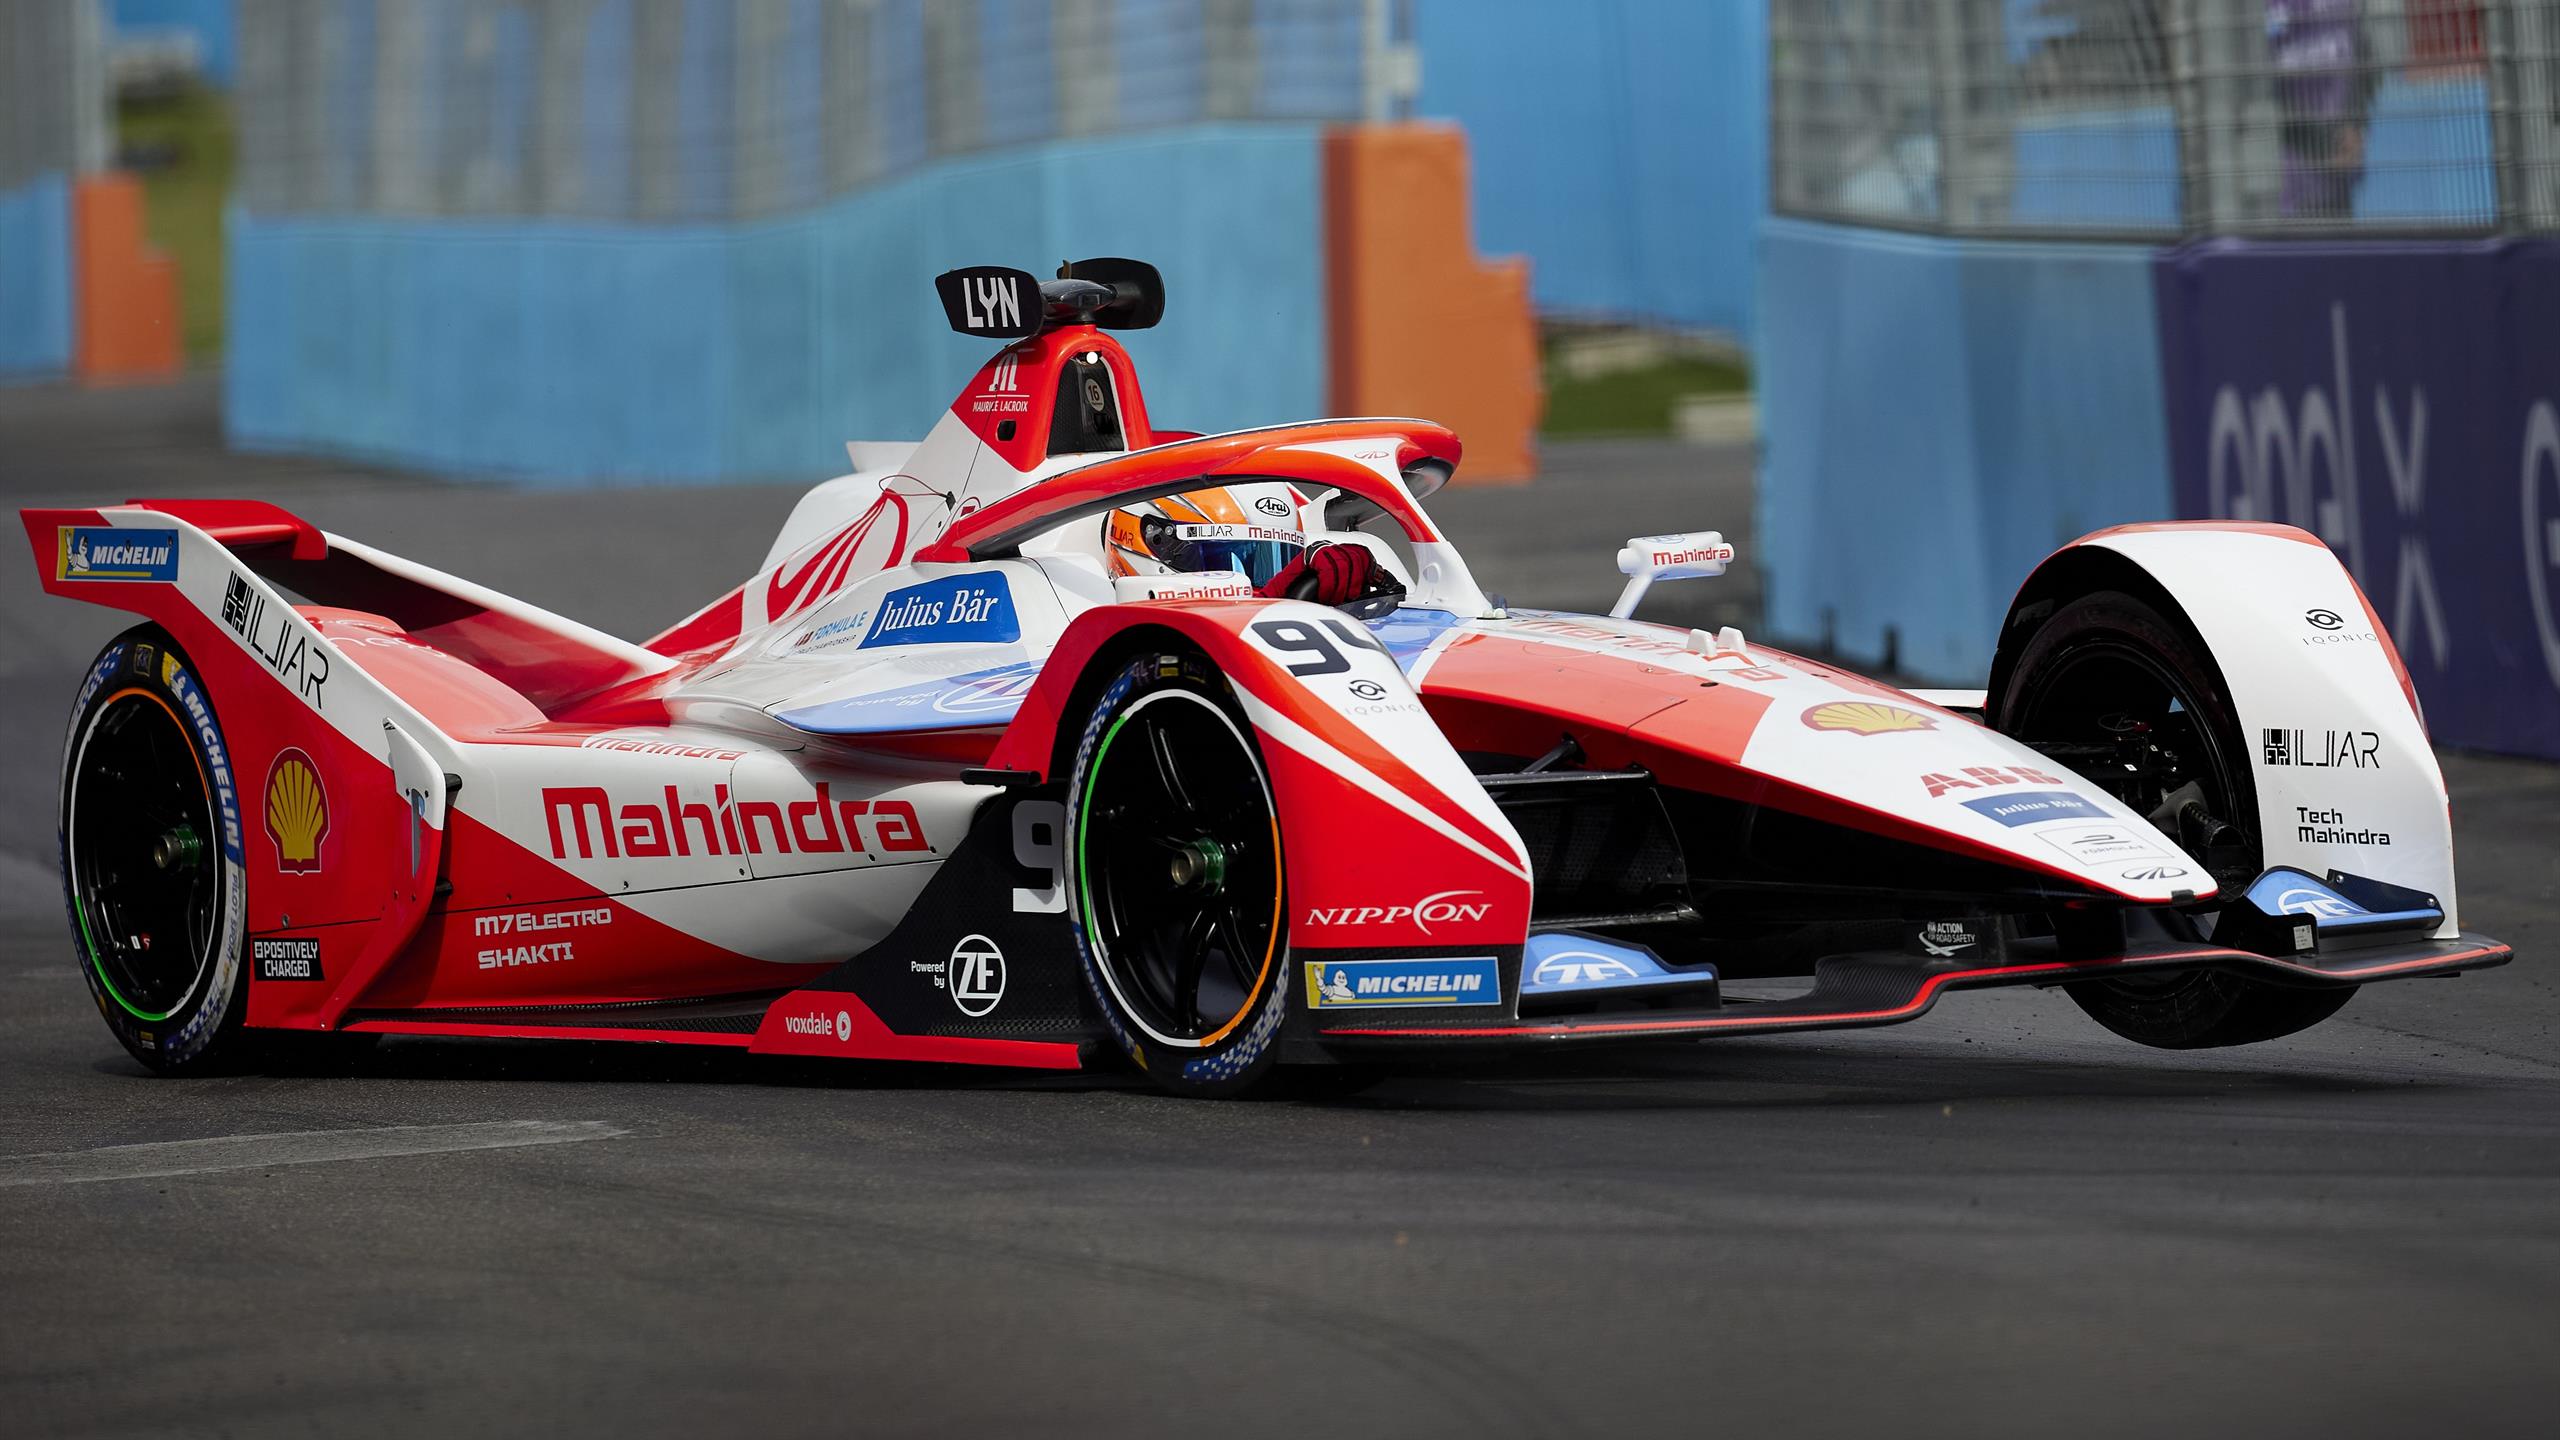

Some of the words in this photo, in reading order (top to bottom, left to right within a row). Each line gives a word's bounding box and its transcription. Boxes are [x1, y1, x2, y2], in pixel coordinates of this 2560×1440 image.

[963, 277, 1020, 328] LYN
[1088, 385, 1100, 401] 16
[1000, 400, 1029, 412] LACROIX
[1259, 498, 1287, 513] Arai
[1248, 527, 1305, 544] Mahindra
[92, 545, 170, 566] MICHELIN
[1653, 547, 1731, 566] Mahindra
[872, 593, 943, 640] Julius
[947, 588, 999, 625] Bär
[2302, 632, 2377, 646] IQONIQ
[585, 737, 748, 761] Mahindra
[185, 692, 240, 849] MICHELIN
[1920, 766, 2064, 799] ABB
[1993, 800, 2049, 817] Julius
[2296, 807, 2344, 825] Tech
[541, 781, 930, 859] Mahindra
[2298, 826, 2391, 845] Mahindra
[1306, 893, 1493, 934] NIPPON
[1937, 922, 1964, 934] ACTION
[1936, 933, 1953, 943] ROAD
[1953, 933, 1977, 943] SAFETY
[263, 941, 319, 959] POSITIVELY
[478, 942, 575, 970] SHAKTI
[264, 959, 311, 977] CHARGED
[911, 960, 945, 973] Powered
[934, 975, 945, 989] by
[1358, 973, 1483, 995] MICHELIN
[785, 1013, 833, 1035] voxdale
